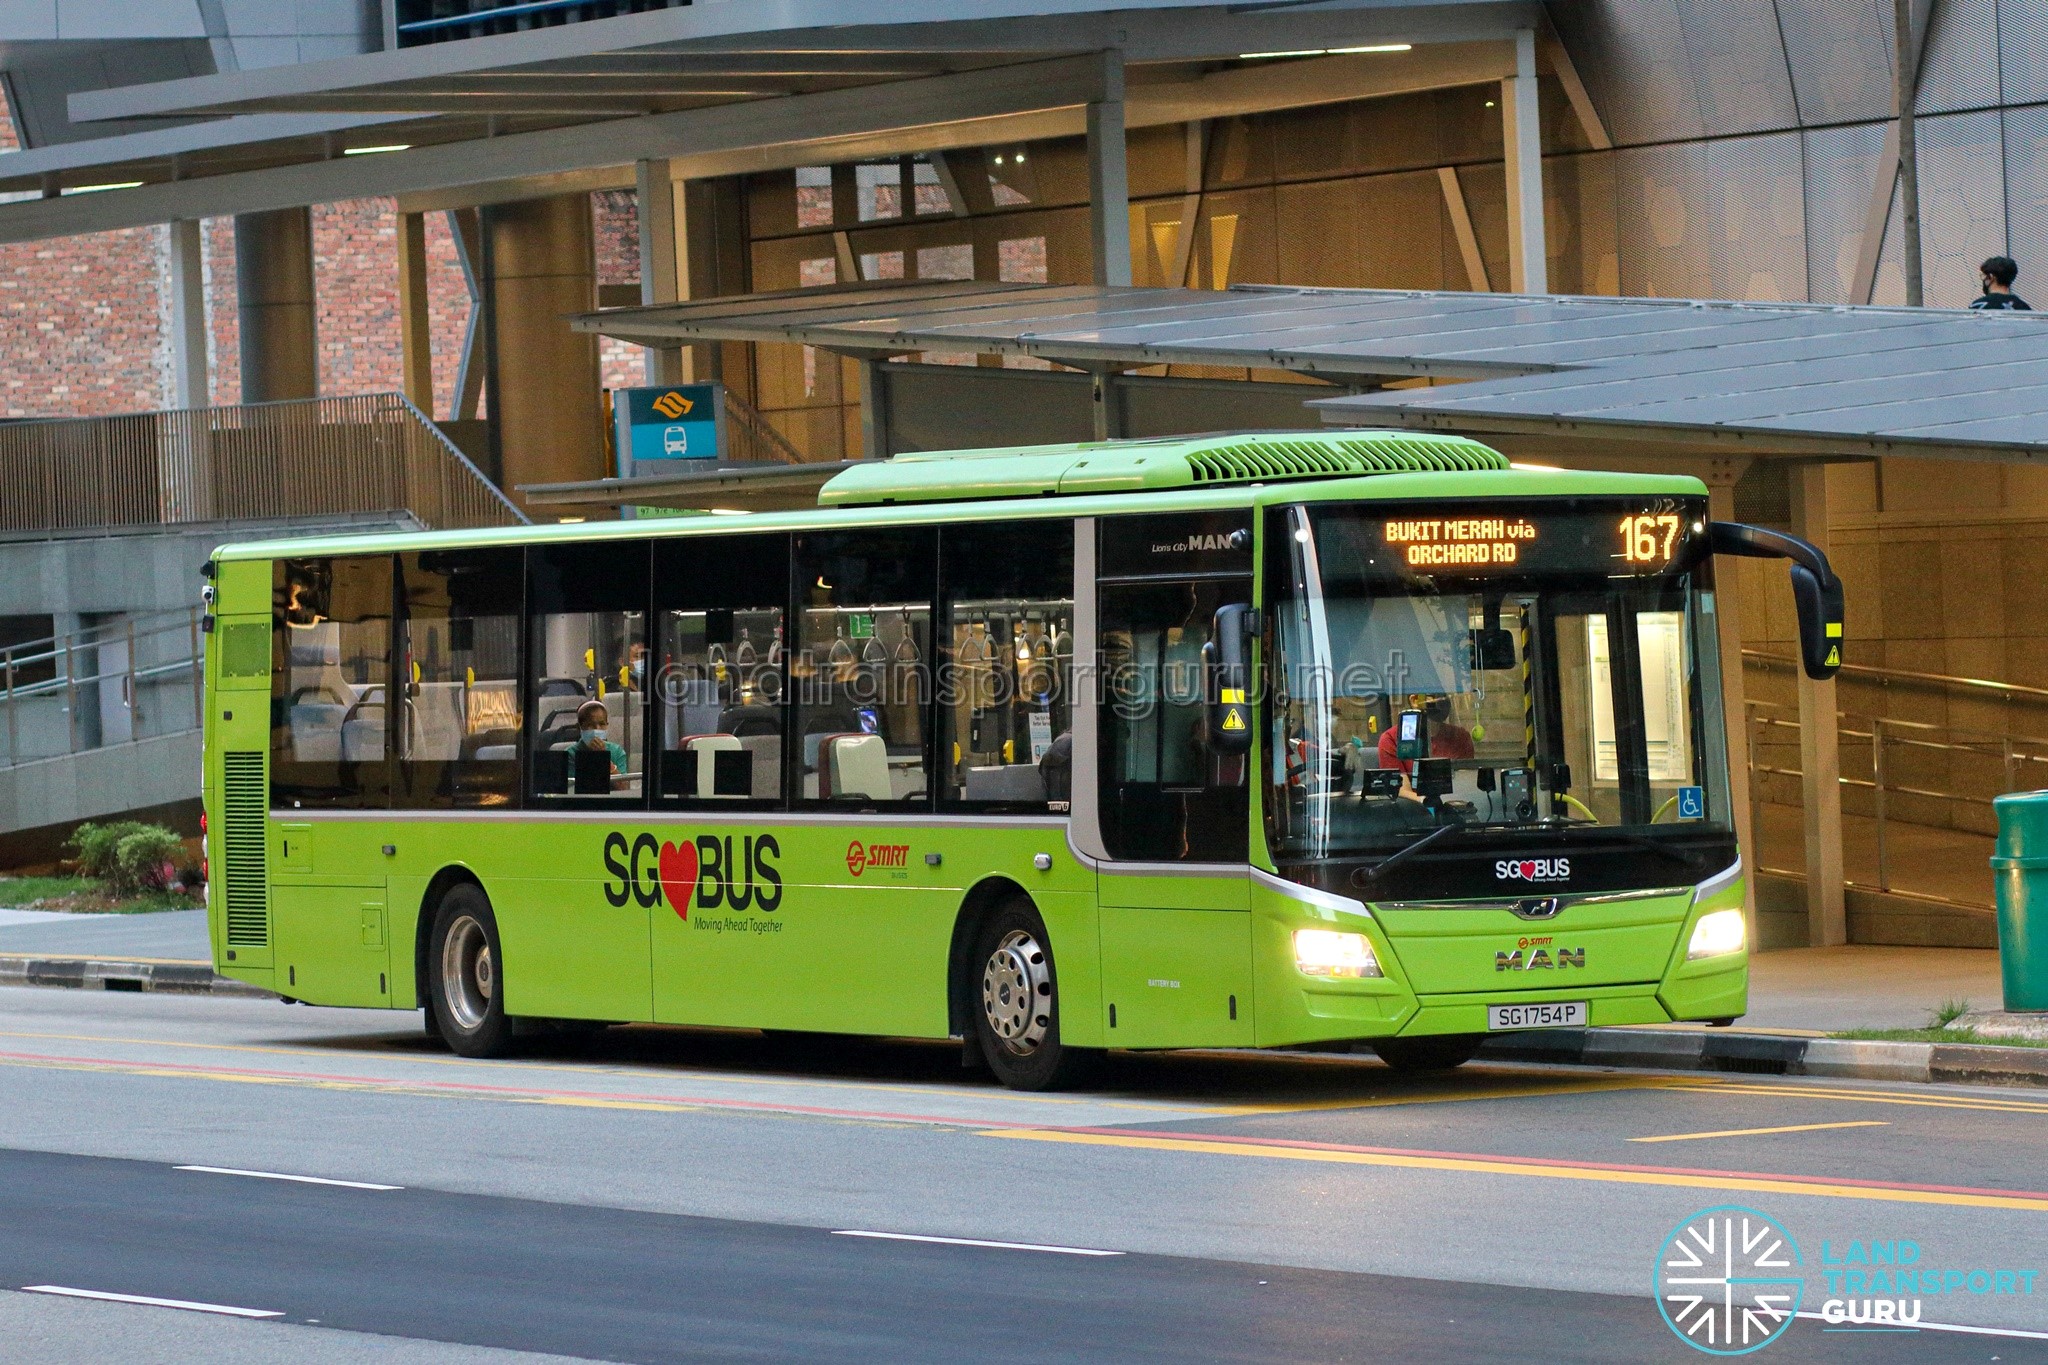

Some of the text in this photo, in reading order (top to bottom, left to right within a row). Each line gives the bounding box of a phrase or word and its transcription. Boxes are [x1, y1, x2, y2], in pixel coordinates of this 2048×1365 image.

[1386, 519, 1535, 541] BUKIT MERAH via
[1618, 515, 1679, 561] 167
[1172, 542, 1188, 552] City
[1188, 534, 1232, 551] MAN
[1408, 542, 1516, 564] ORCHARD RD
[867, 844, 910, 867] SMRT
[694, 917, 783, 935] Moving Ahead Together
[1530, 937, 1553, 946] SMRT
[1495, 948, 1585, 971] MAN
[1499, 1006, 1576, 1026] SG1754P
